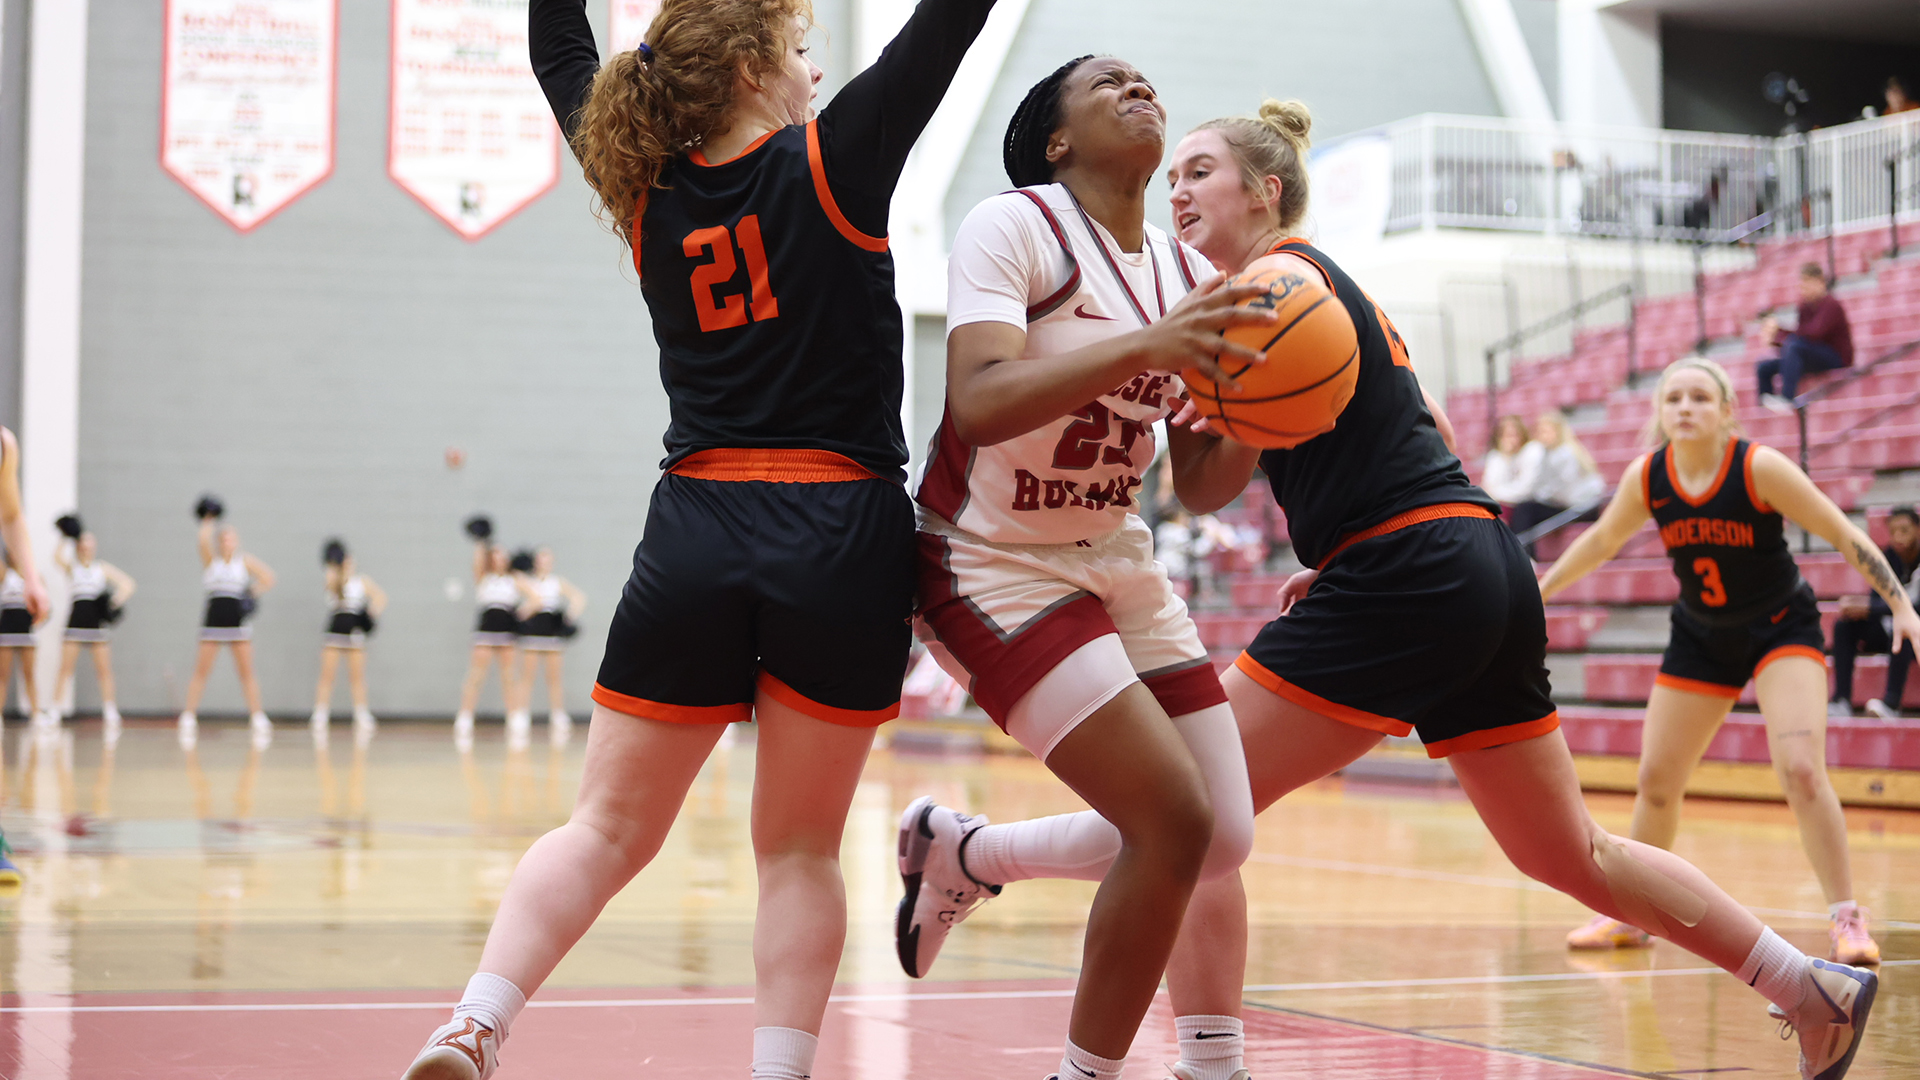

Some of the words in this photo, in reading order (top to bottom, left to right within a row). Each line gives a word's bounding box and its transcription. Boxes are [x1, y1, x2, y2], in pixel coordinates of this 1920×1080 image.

[682, 213, 779, 333] 21
[1659, 517, 1754, 550] NDERSON
[1693, 557, 1727, 607] 3
